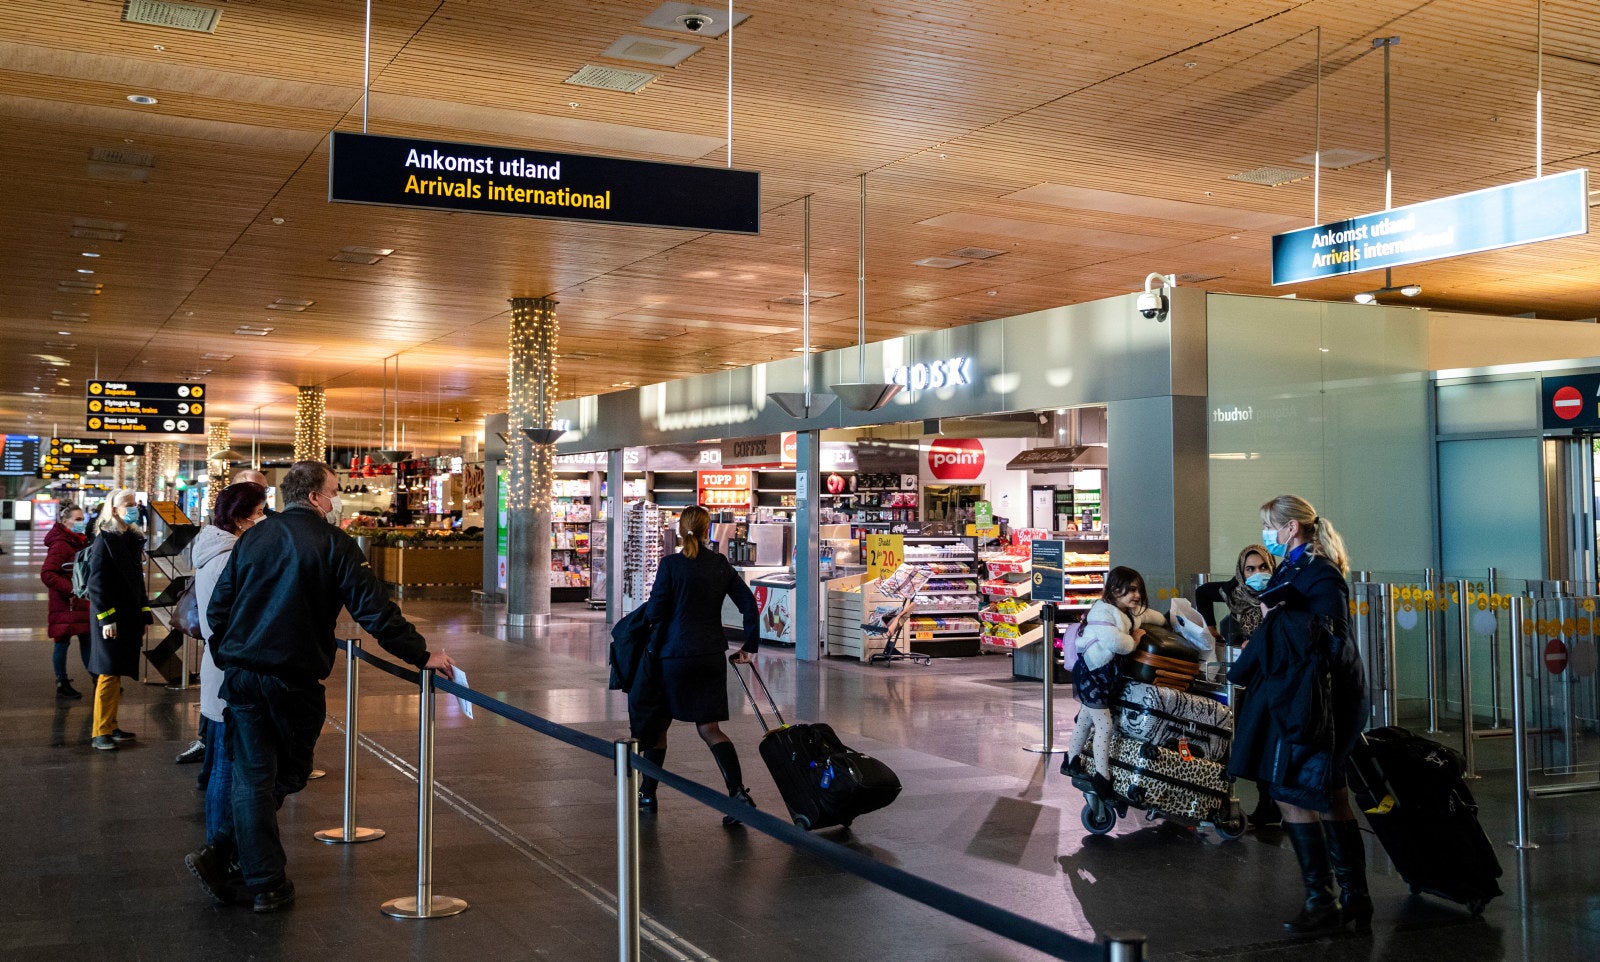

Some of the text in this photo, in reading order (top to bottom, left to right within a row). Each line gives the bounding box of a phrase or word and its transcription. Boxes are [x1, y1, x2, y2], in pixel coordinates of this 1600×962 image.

[405, 148, 561, 181] Ankomst utland
[404, 174, 611, 211] Arrivals international
[1312, 213, 1415, 248] Ankomst utland
[1312, 225, 1454, 268] Arrivals international
[734, 439, 767, 458] COFFEE
[934, 448, 979, 468] point
[702, 474, 747, 485] TOPP 10
[870, 549, 877, 566] 2
